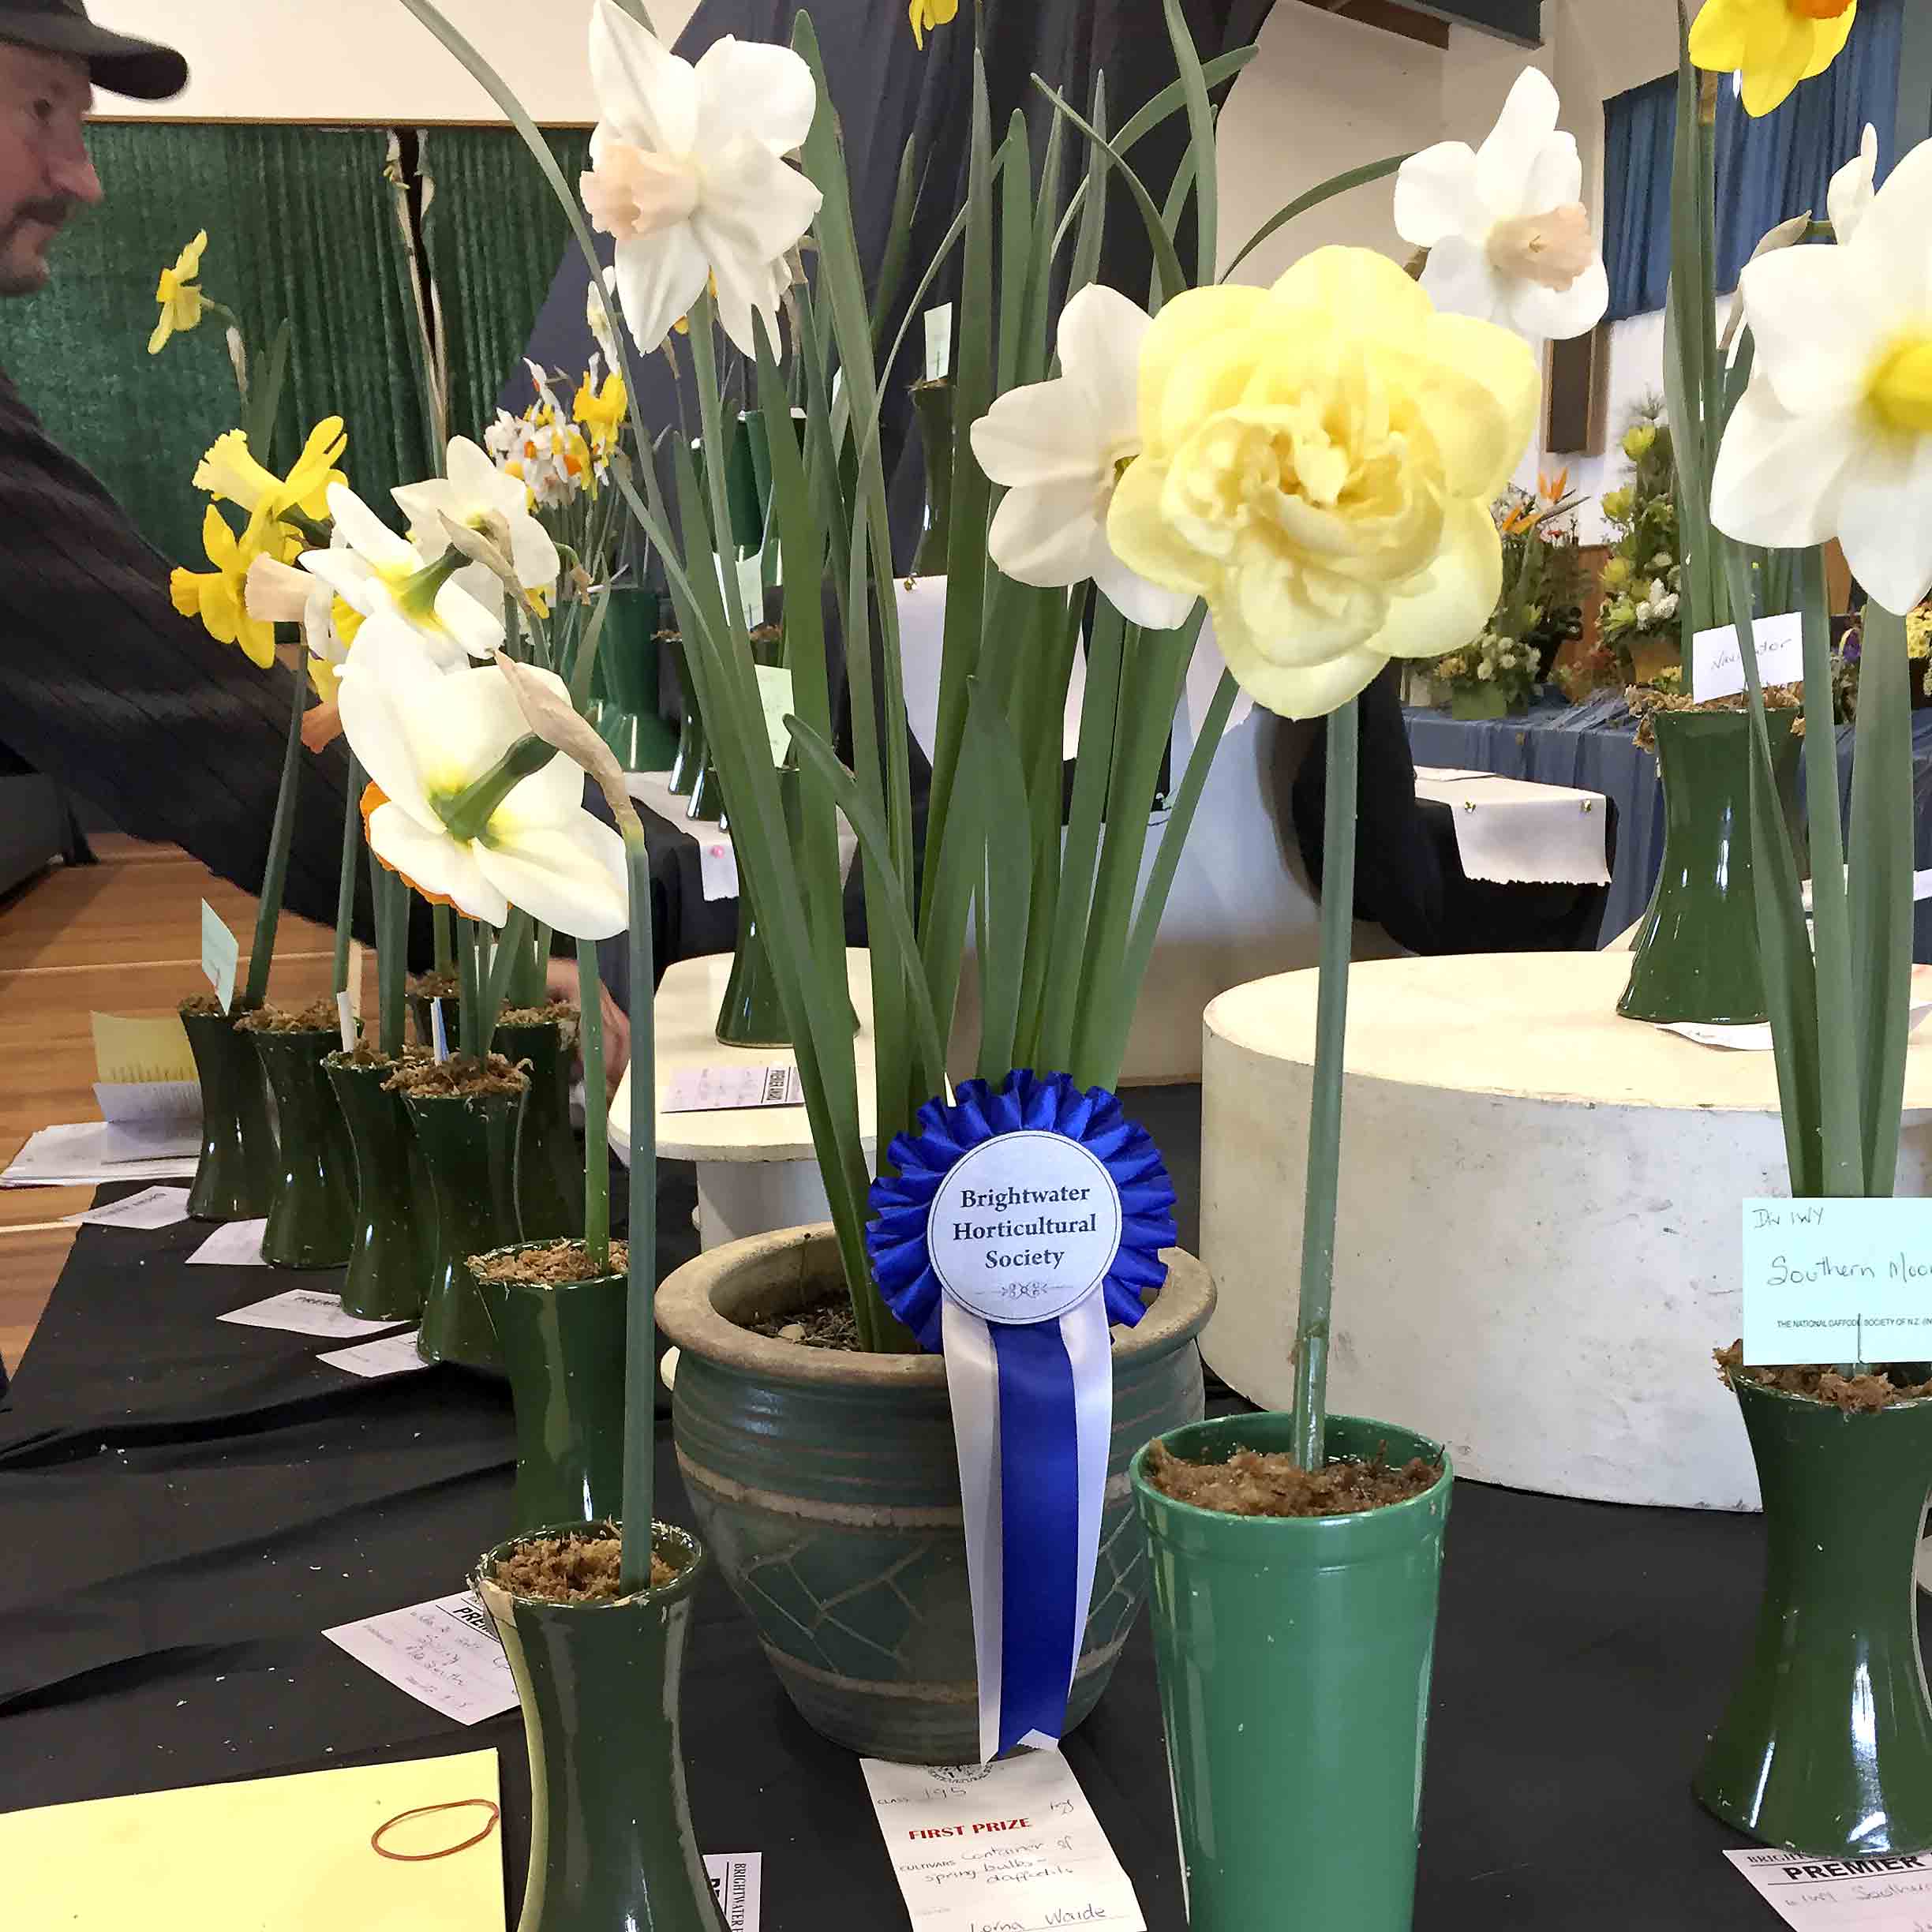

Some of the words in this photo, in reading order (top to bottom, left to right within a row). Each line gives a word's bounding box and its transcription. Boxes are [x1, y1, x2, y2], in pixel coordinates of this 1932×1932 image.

[960, 1186, 1091, 1212] Brightwater
[953, 1214, 1096, 1241] Horticultural
[985, 1249, 1065, 1270] Society
[1767, 1254, 1875, 1286] Southern
[1889, 1251, 1932, 1283] Moo
[908, 1825, 964, 1840] FIRST
[972, 1818, 1032, 1834] PRIZE
[1782, 1855, 1926, 1880] PREMIER
[732, 1863, 746, 1926] BRIGHTWATER
[1045, 1903, 1106, 1925] Waide
